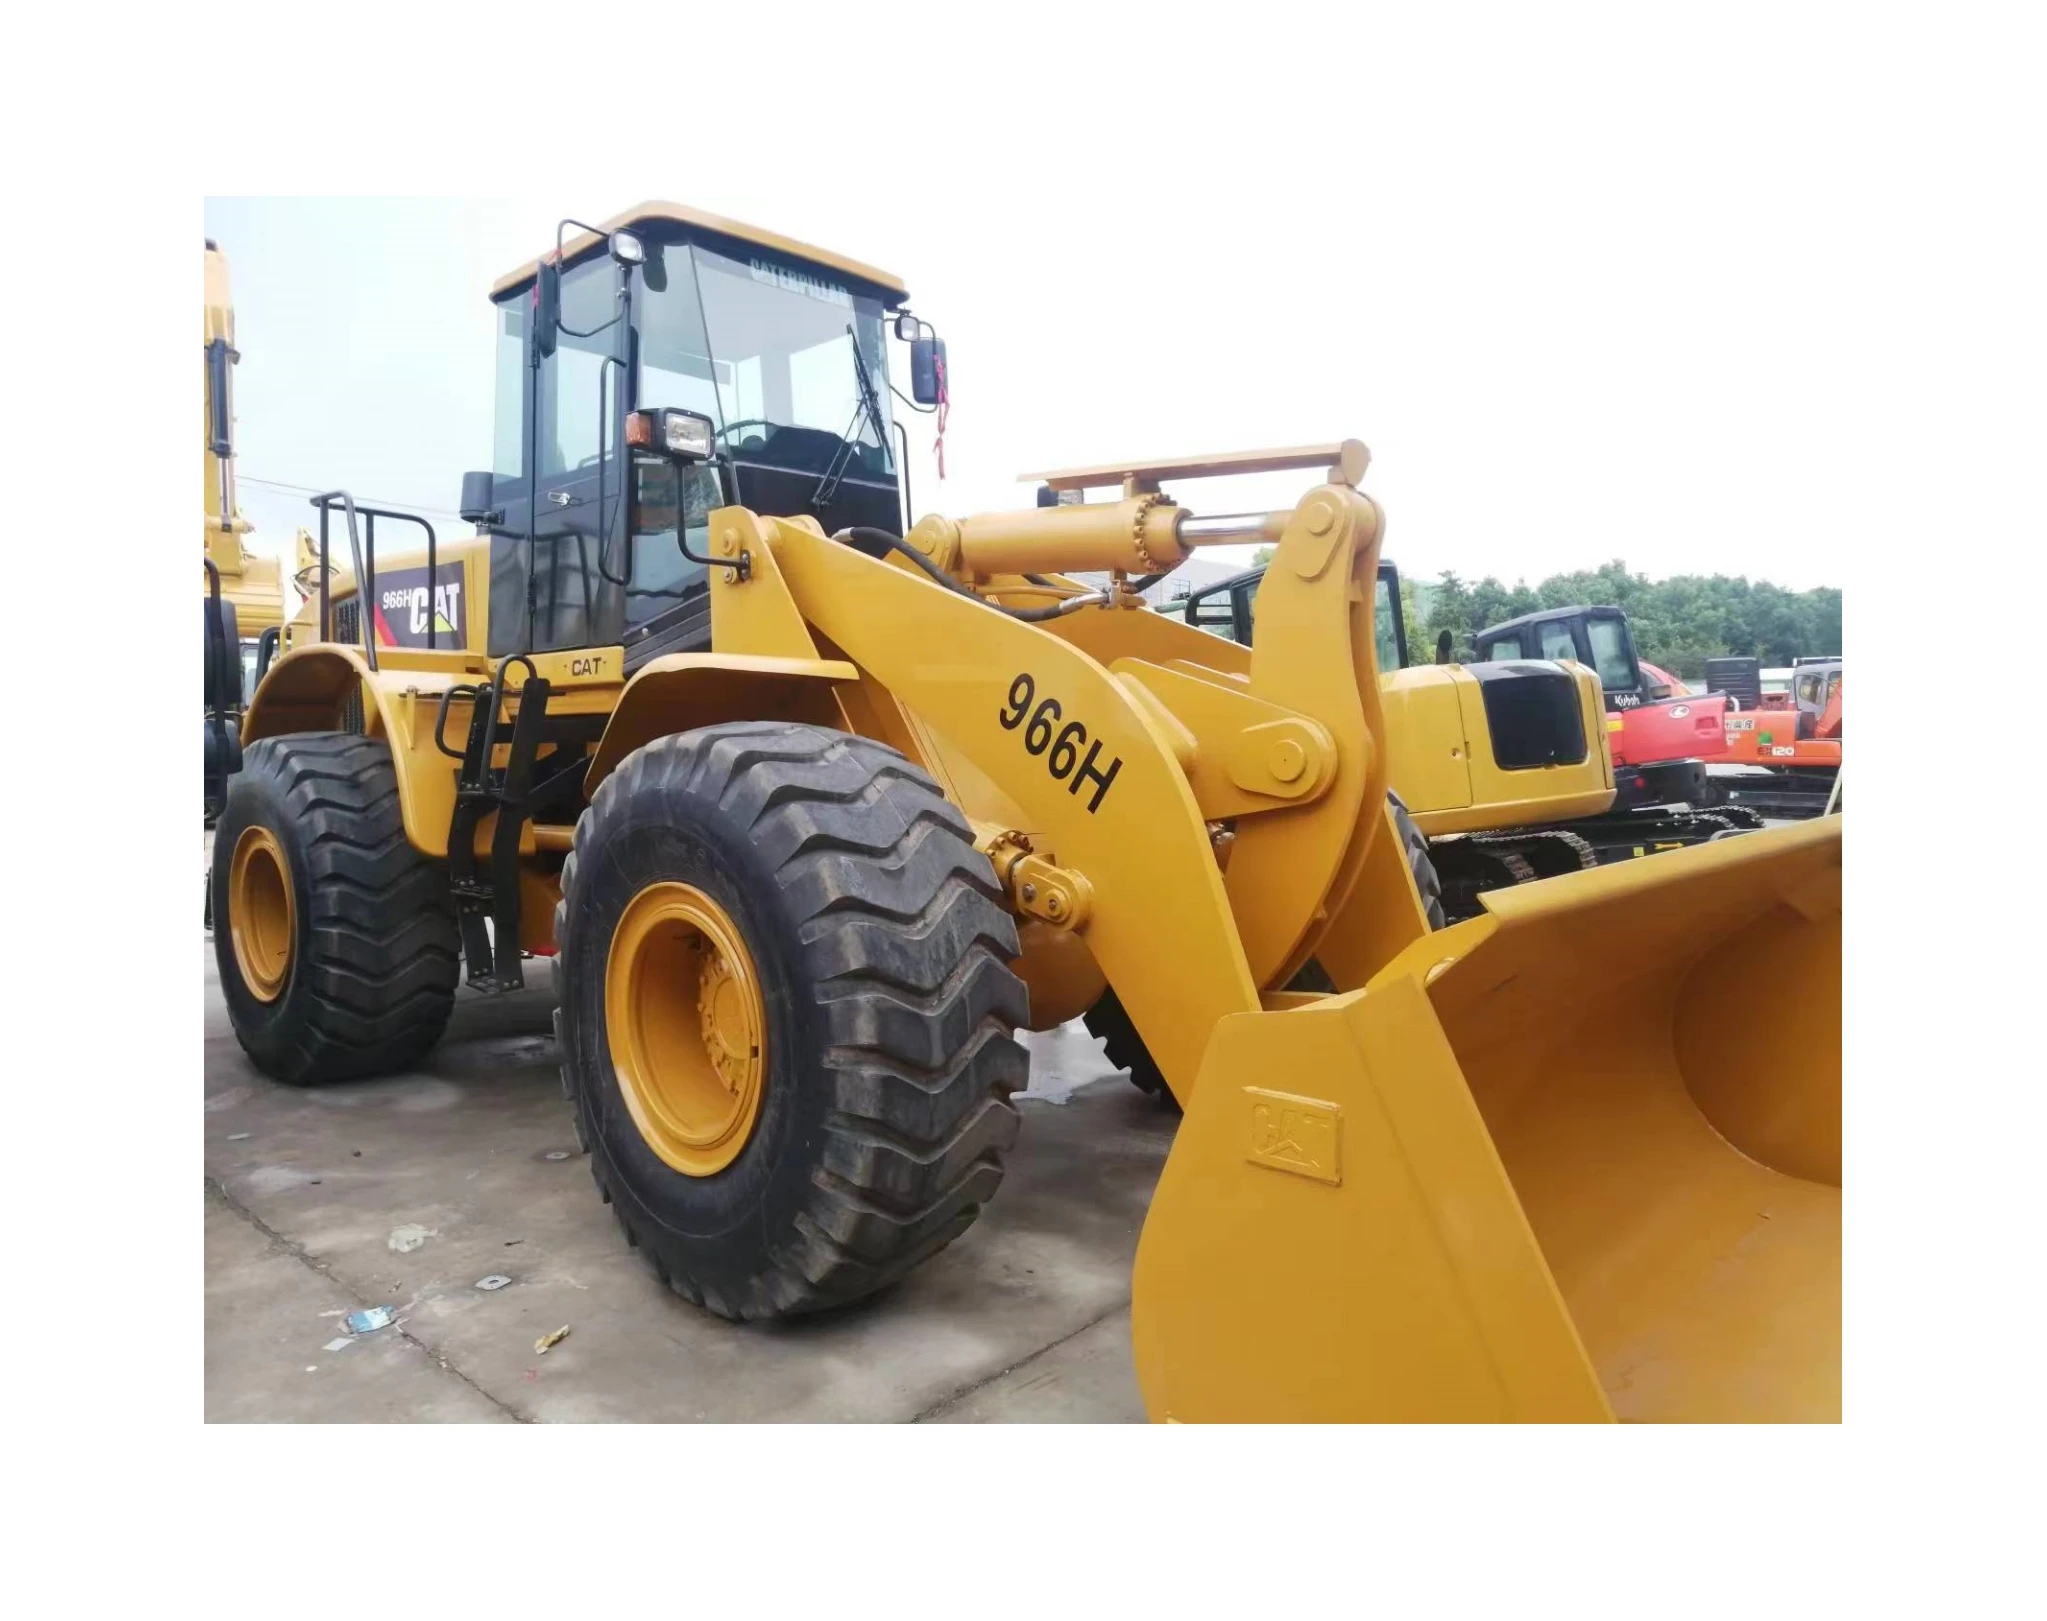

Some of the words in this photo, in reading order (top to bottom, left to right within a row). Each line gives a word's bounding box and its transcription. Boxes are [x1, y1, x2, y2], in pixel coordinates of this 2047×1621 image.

[382, 590, 411, 610] 966H
[409, 582, 460, 634] CAT
[572, 657, 603, 676] CAT
[1000, 673, 1123, 814] 966H
[1757, 746, 1795, 757] EX120
[1252, 1103, 1331, 1169] CAT
